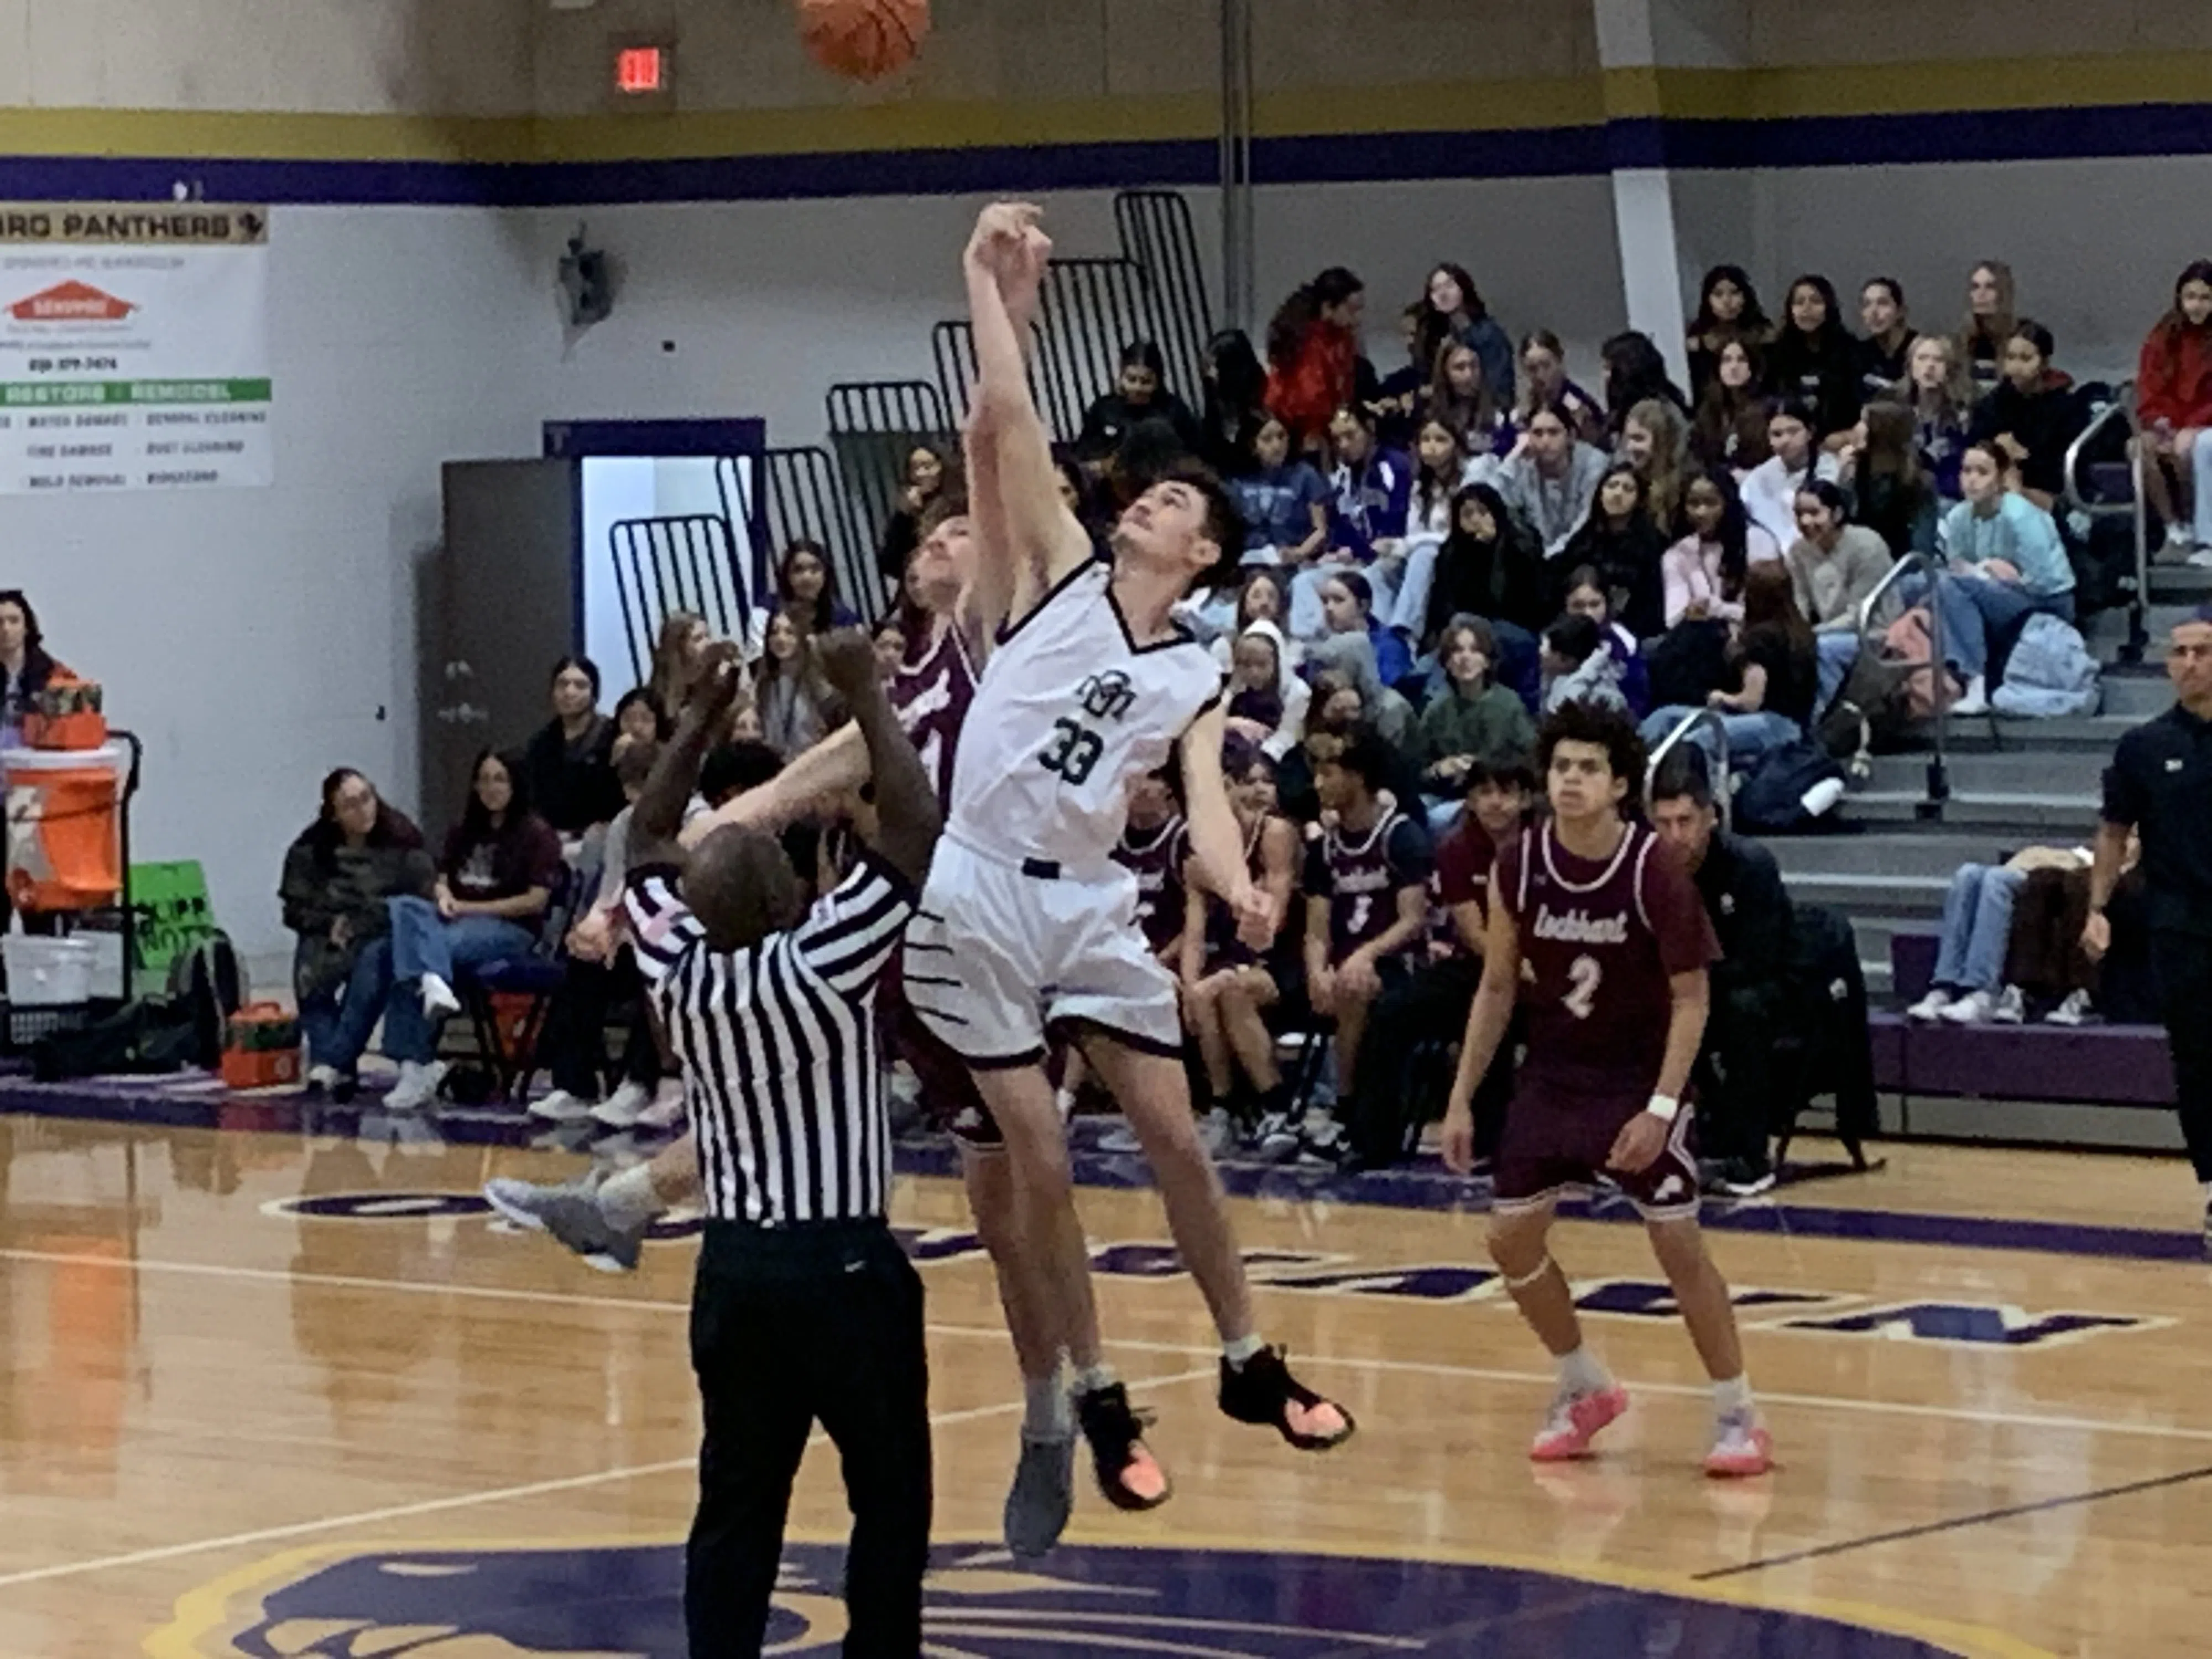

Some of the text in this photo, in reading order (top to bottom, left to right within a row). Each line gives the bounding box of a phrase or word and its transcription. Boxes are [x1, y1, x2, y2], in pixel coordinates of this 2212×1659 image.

[0, 213, 51, 237] RO
[1038, 717, 1103, 786] 33
[1559, 953, 1602, 1019] 2
